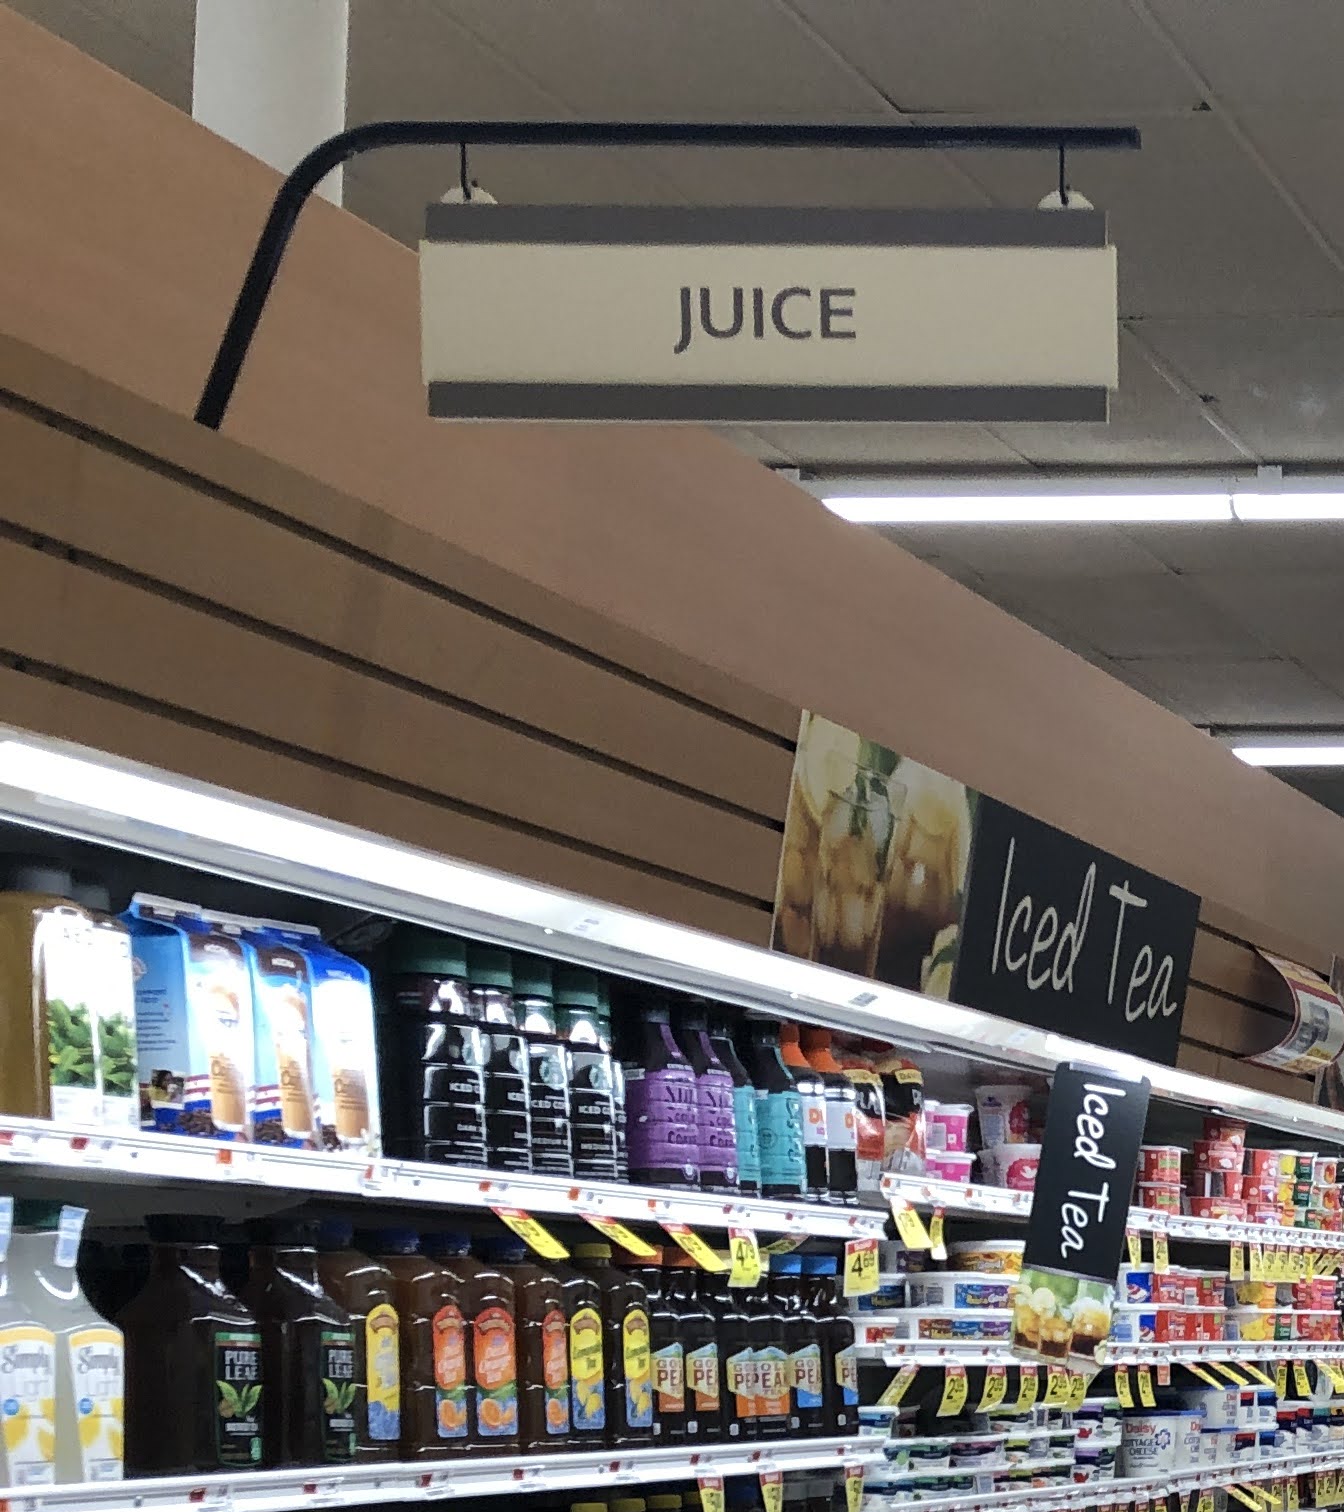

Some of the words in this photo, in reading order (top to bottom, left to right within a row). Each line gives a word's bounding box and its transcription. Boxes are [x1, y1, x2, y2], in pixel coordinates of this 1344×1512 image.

[672, 285, 859, 356] JUICE
[991, 837, 1097, 995] Iced
[1107, 880, 1178, 1022] Tea
[1074, 1083, 1127, 1170] Iced
[1061, 1181, 1116, 1260] Tea
[224, 1350, 258, 1365] PURE
[224, 1364, 258, 1380] LEAF
[1126, 1422, 1157, 1435] Daisy
